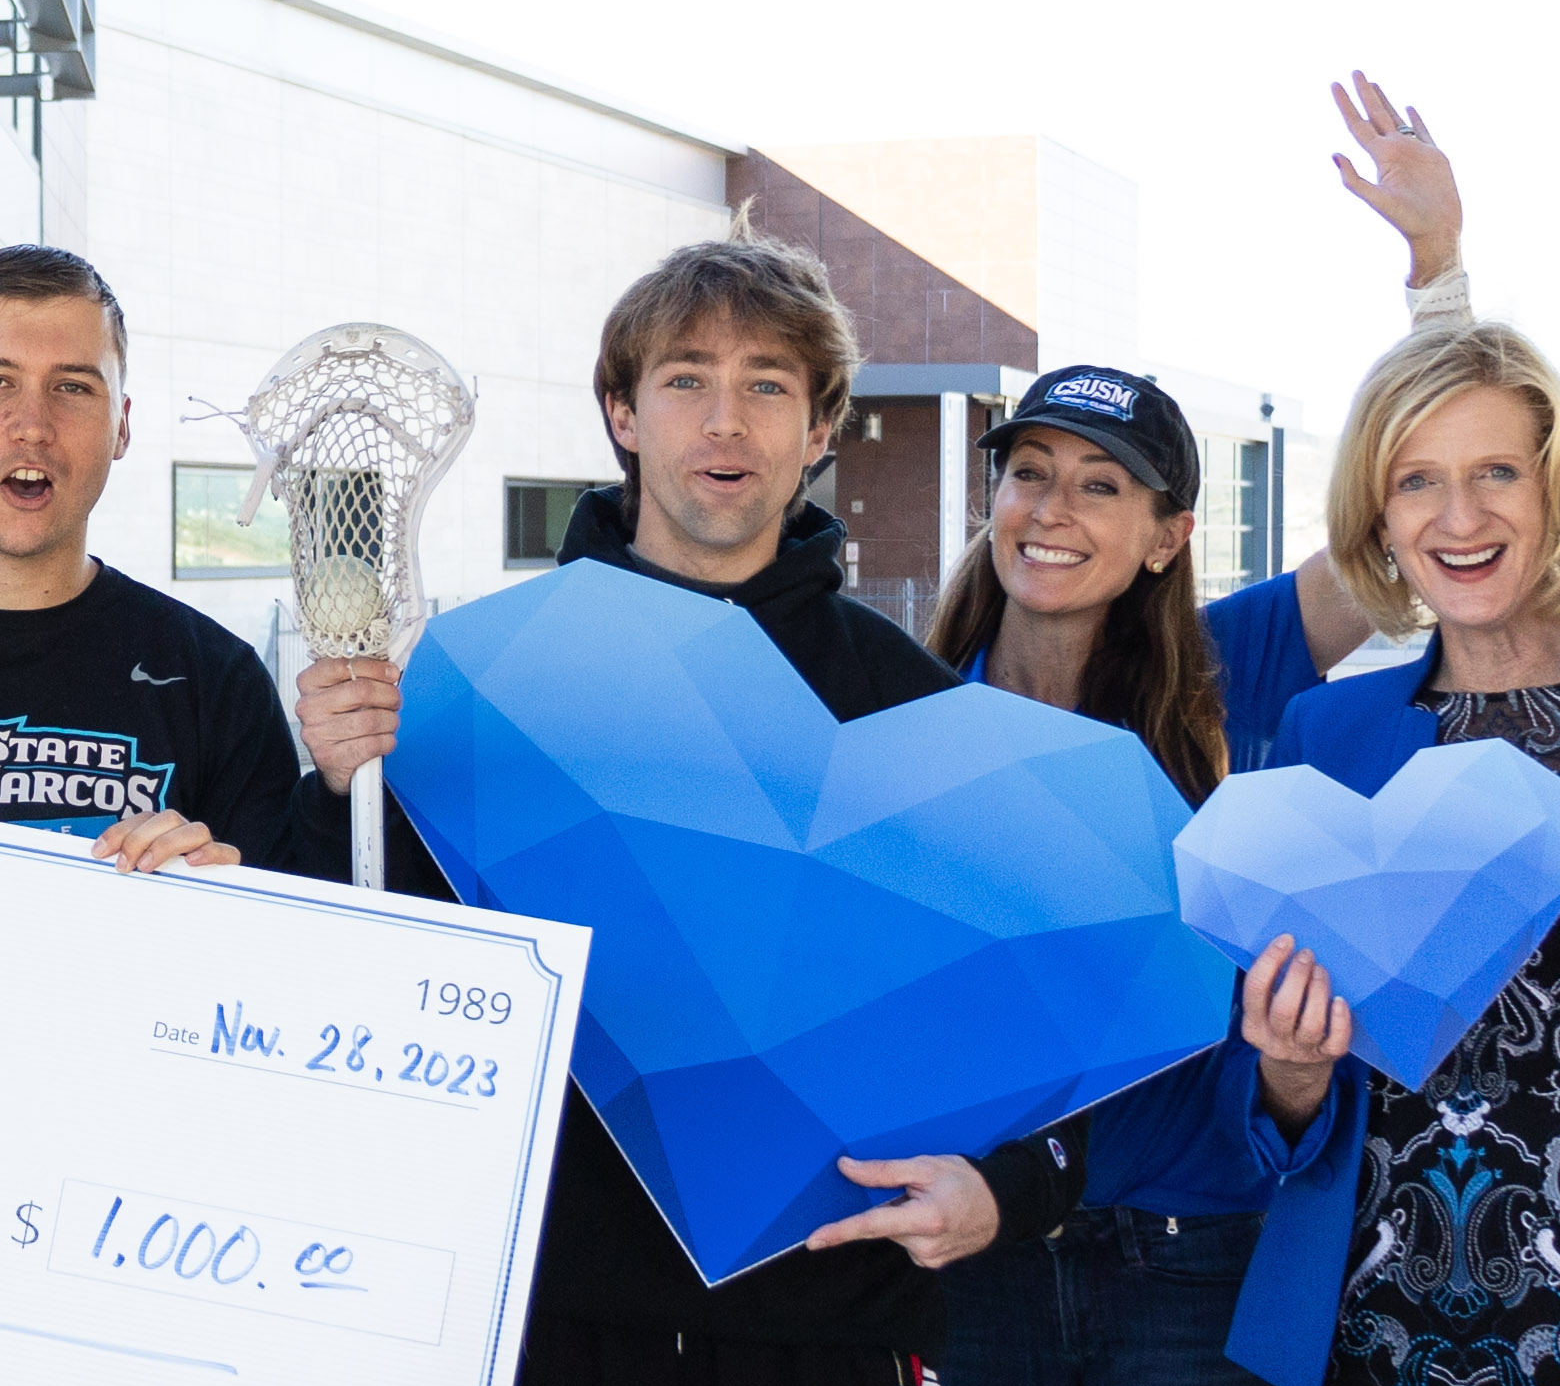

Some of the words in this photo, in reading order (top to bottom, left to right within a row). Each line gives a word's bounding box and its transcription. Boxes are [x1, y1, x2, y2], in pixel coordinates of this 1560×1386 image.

[1053, 378, 1133, 409] CSUSM
[416, 978, 513, 1025] 1989
[153, 1021, 199, 1046] Date
[211, 1000, 285, 1057] Nov.
[399, 1042, 500, 1098] 2023
[11, 1200, 43, 1249] $
